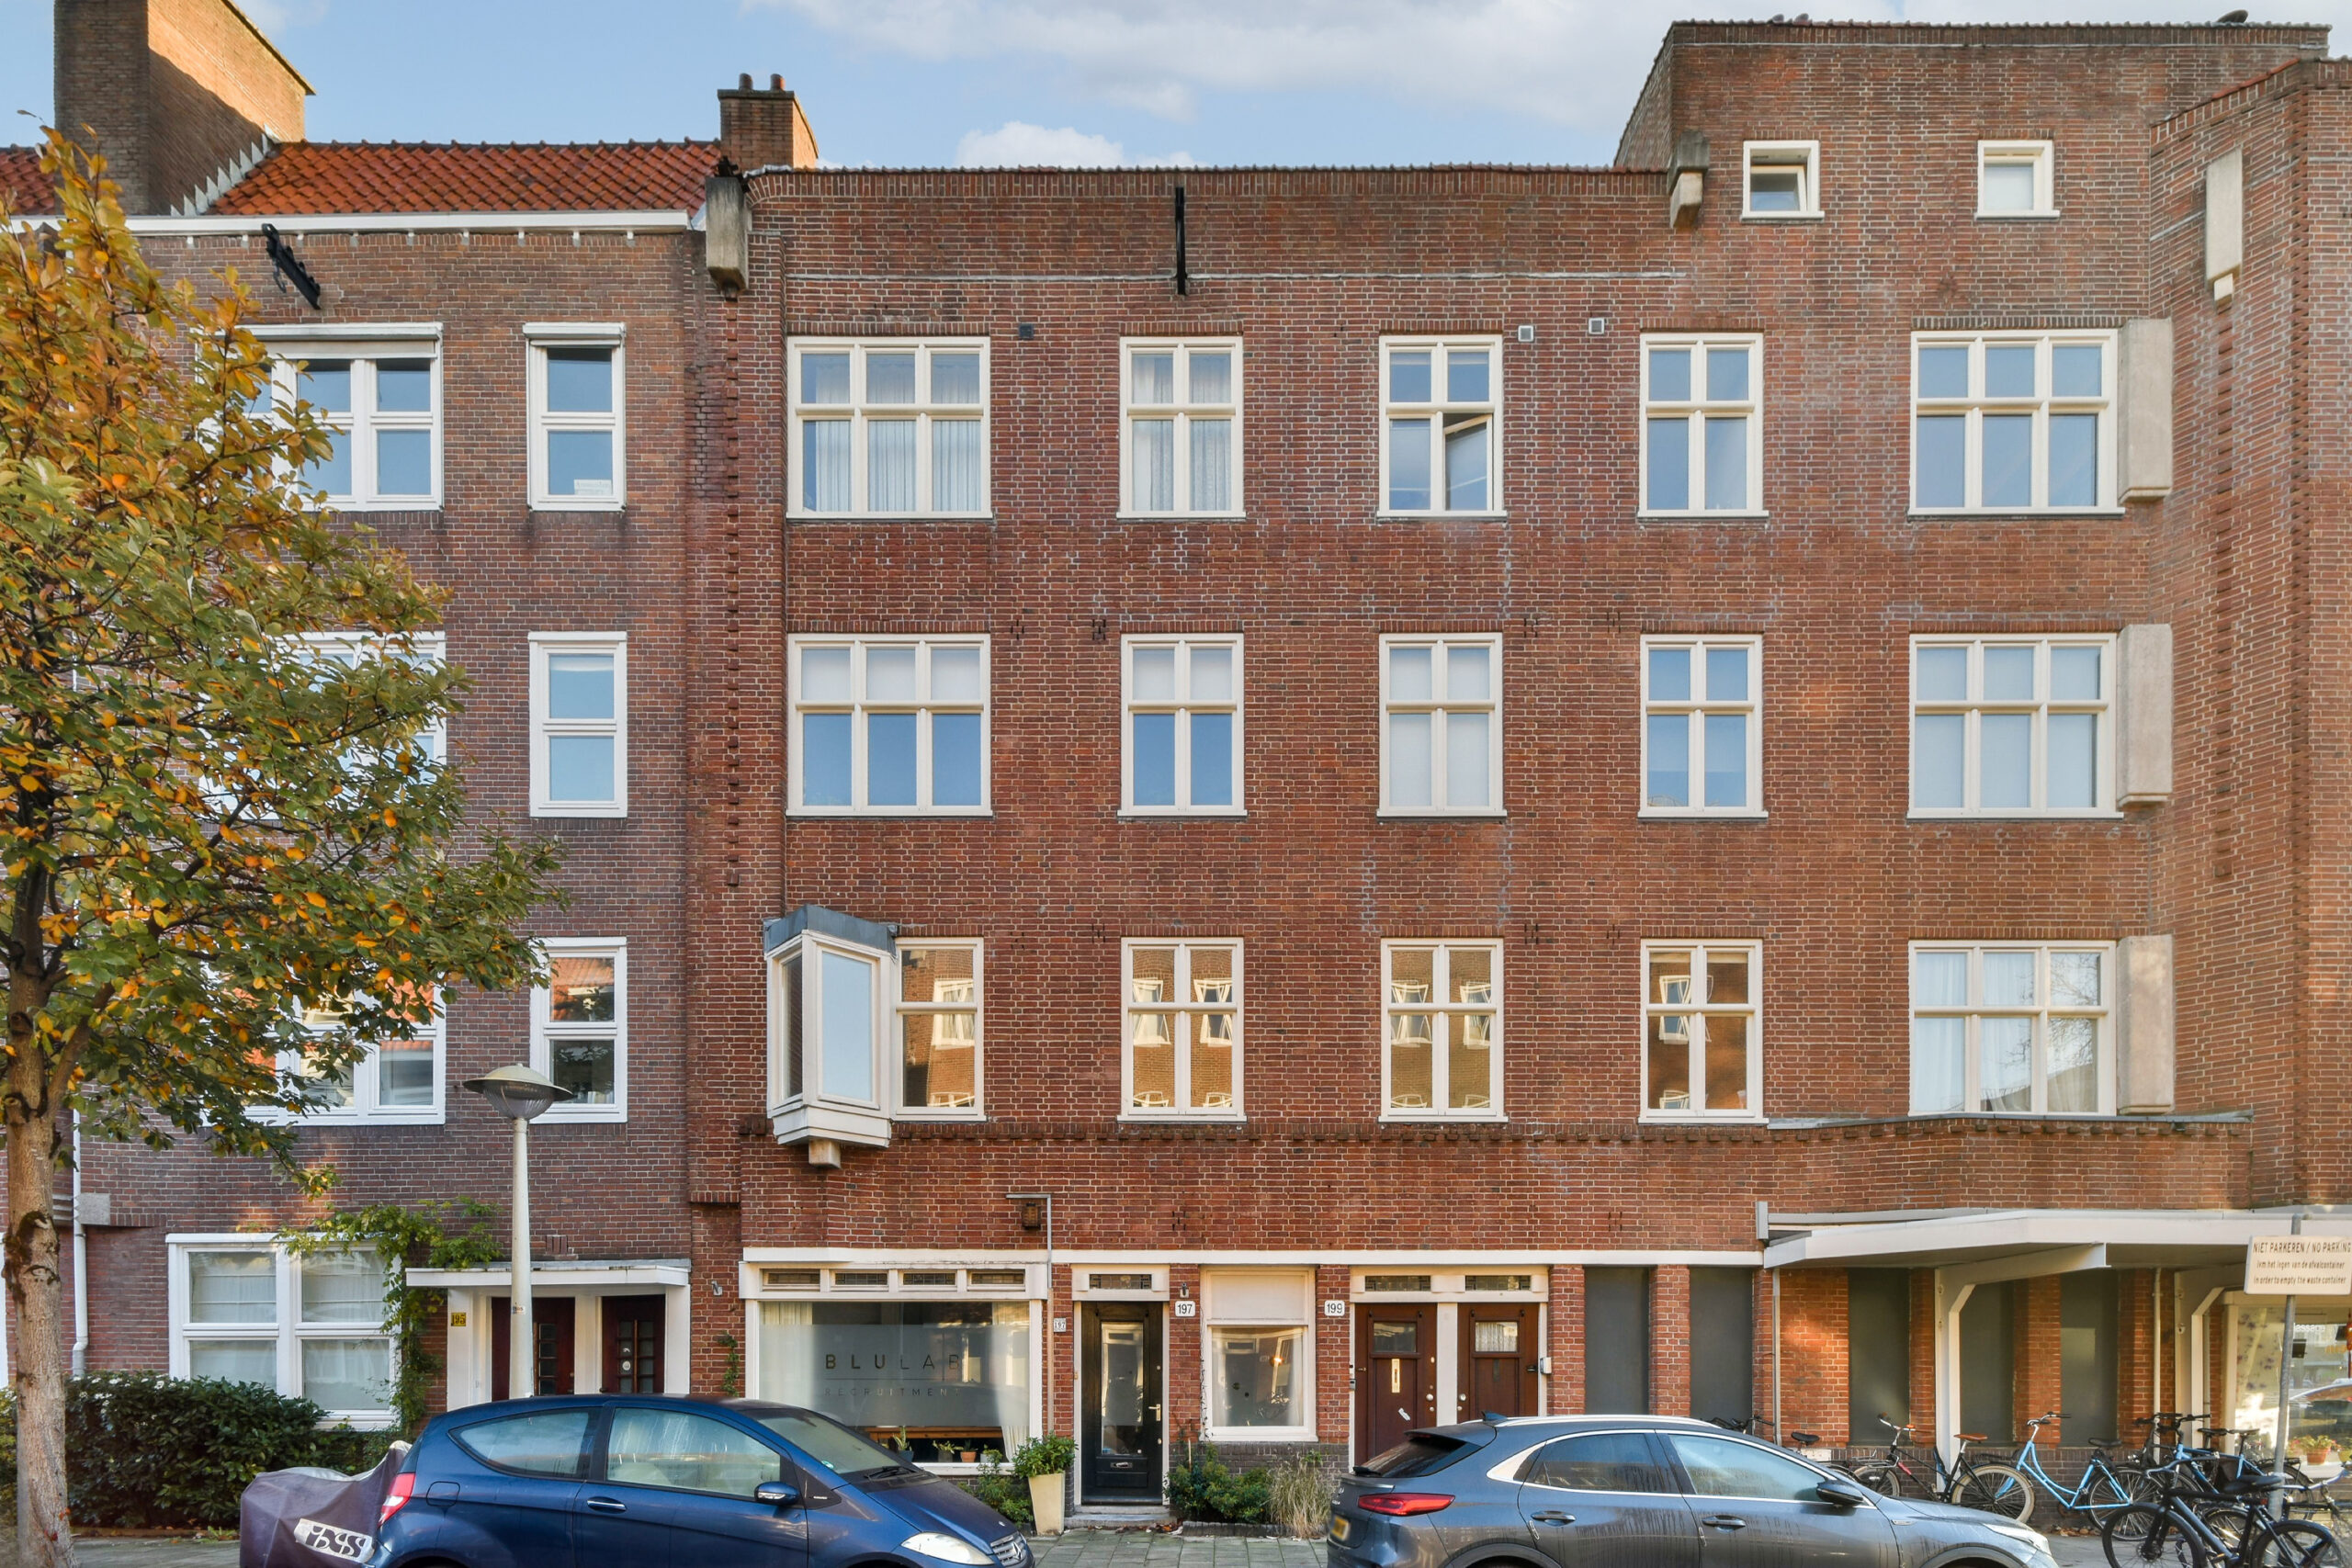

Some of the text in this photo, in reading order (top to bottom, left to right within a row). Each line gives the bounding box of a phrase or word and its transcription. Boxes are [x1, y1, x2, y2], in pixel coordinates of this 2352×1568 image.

[2254, 1242, 2268, 1253] NIET
[2269, 1242, 2304, 1253] PARKEREN
[2312, 1242, 2321, 1253] NO
[2323, 1241, 2351, 1253] PARKING
[2301, 1260, 2308, 1269] de
[2260, 1275, 2274, 1284] order
[2274, 1276, 2279, 1284] to
[2280, 1276, 2296, 1286] empty
[2297, 1276, 2306, 1284] the
[2307, 1276, 2321, 1284] waste
[2322, 1275, 2346, 1284] container
[1177, 1303, 1193, 1314] 197
[1327, 1303, 1342, 1314] 199
[452, 1314, 466, 1325] 195
[825, 1354, 960, 1370] BLULAB
[825, 1388, 963, 1396] RECRUITMENT
